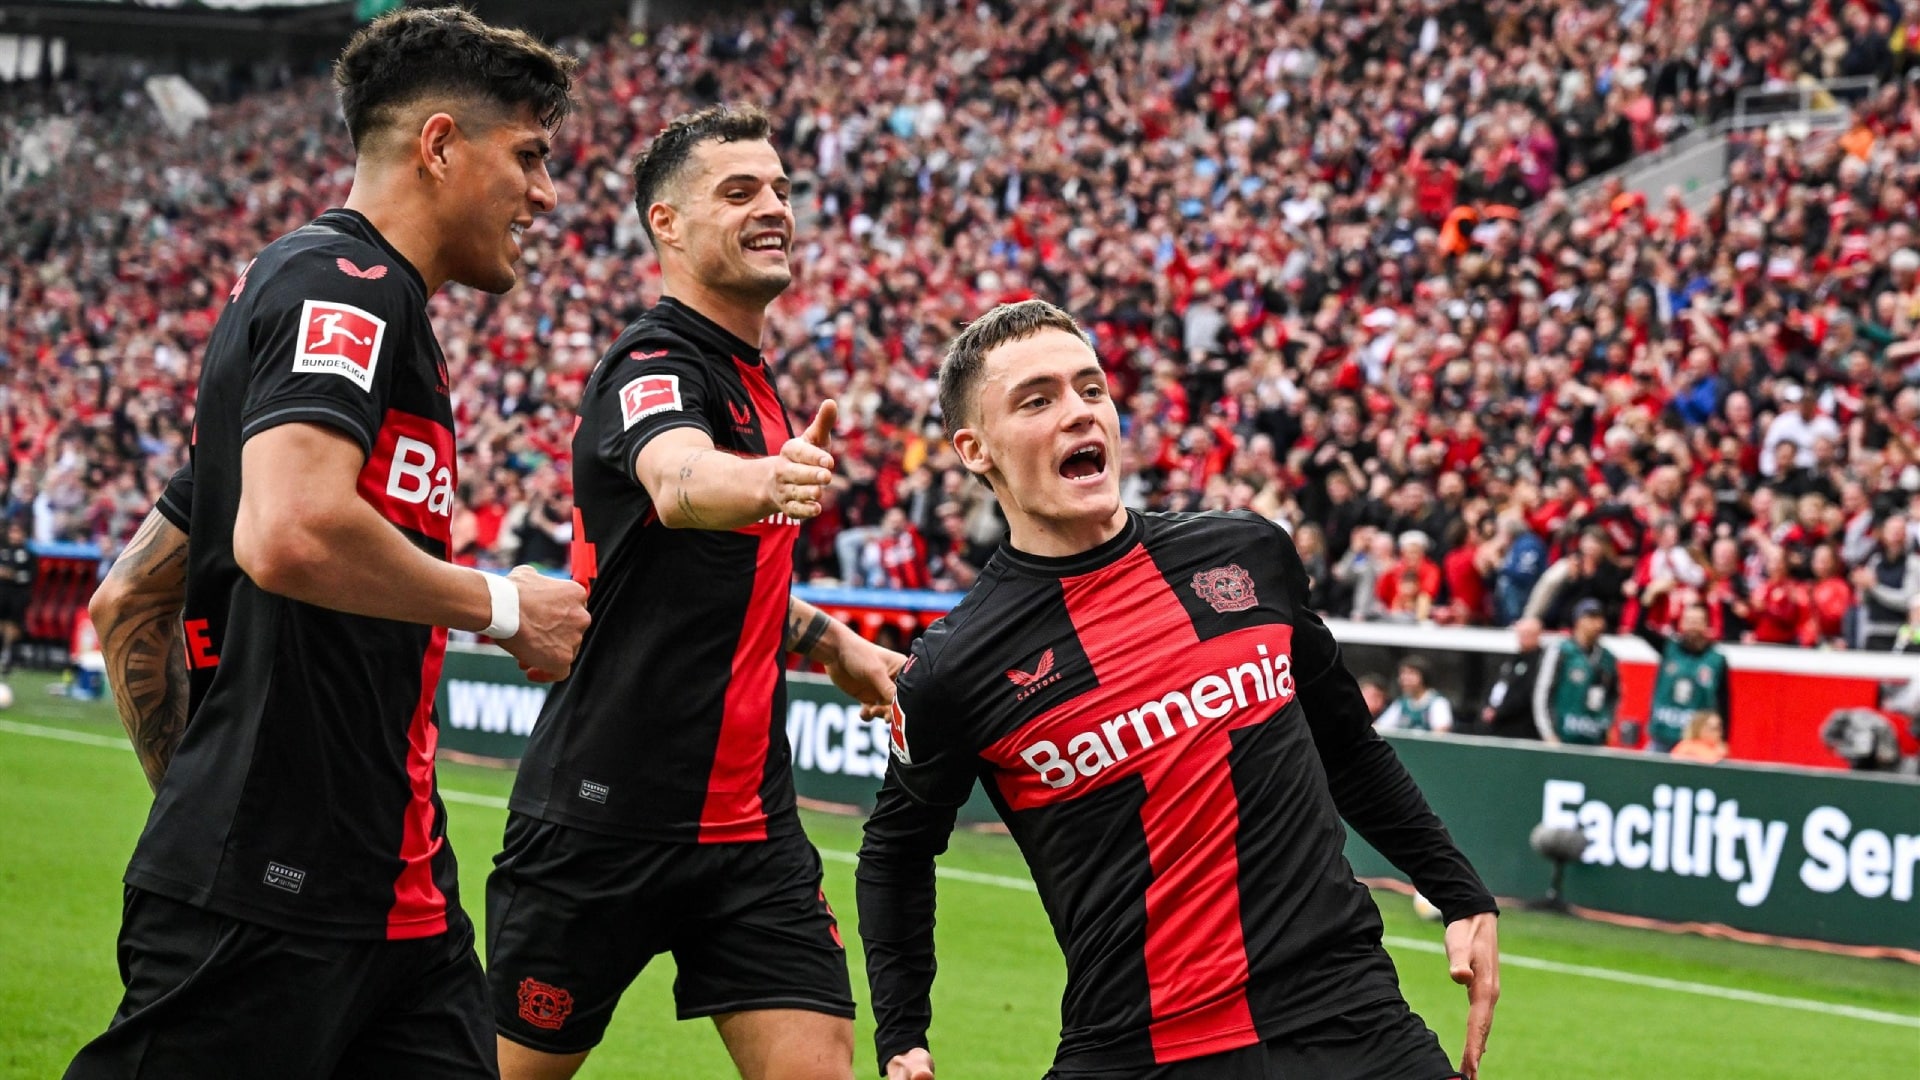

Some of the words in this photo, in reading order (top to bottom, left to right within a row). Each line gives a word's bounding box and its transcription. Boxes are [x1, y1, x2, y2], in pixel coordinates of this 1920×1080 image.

[302, 358, 366, 383] BUNDESLIGA
[386, 435, 455, 517] Ba
[1016, 672, 1062, 701] CASTORE
[1019, 644, 1294, 789] Barmenia
[1542, 779, 1788, 906] Facility
